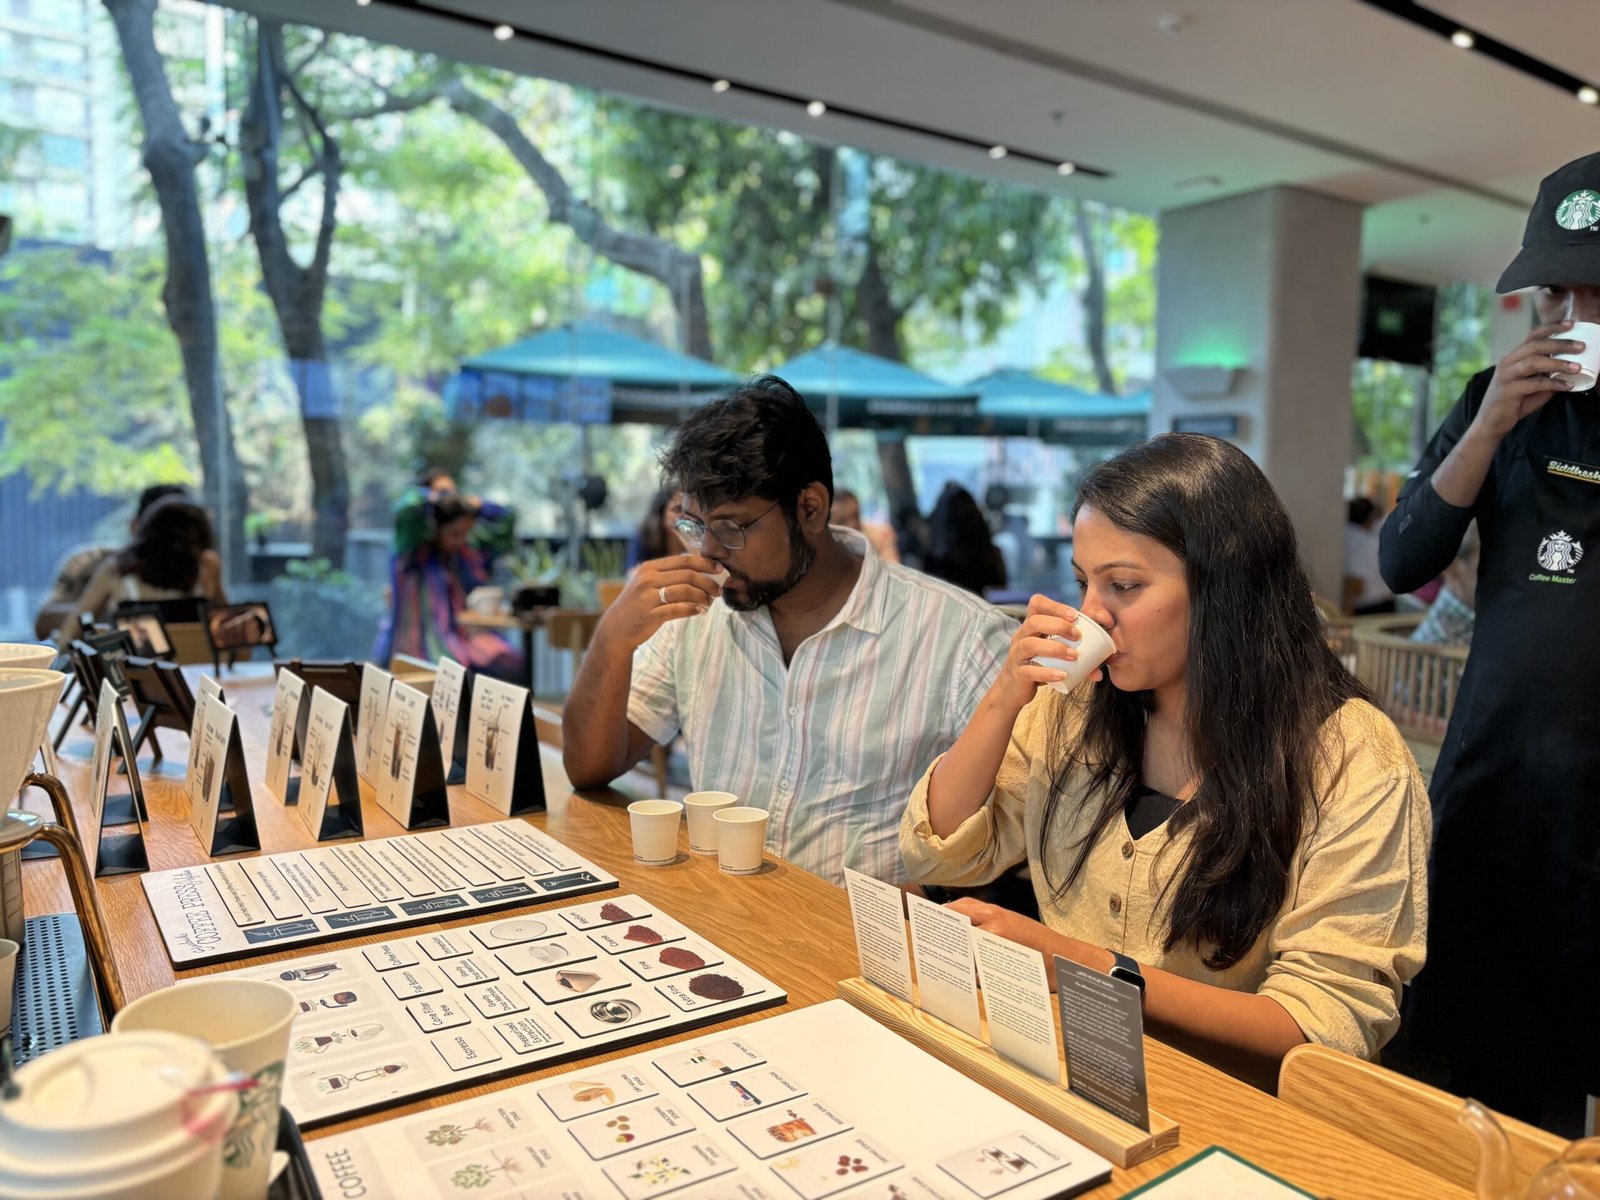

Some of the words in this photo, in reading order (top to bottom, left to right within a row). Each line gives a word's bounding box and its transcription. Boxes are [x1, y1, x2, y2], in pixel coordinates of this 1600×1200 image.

[1529, 573, 1551, 582] Coffee
[1551, 575, 1577, 585] Master
[174, 882, 204, 910] PRESS
[186, 910, 221, 945] COFFEE
[601, 934, 619, 947] Coarse
[639, 960, 653, 970] Fine
[679, 993, 696, 1006] Extra
[421, 1002, 434, 1015] Filter
[440, 1004, 454, 1016] Brew
[429, 1012, 443, 1026] Cone
[504, 1021, 533, 1048] Pressurized
[517, 1021, 543, 1044] Extraction
[455, 1036, 477, 1060] Espresso
[325, 1148, 367, 1199] COFFEE
